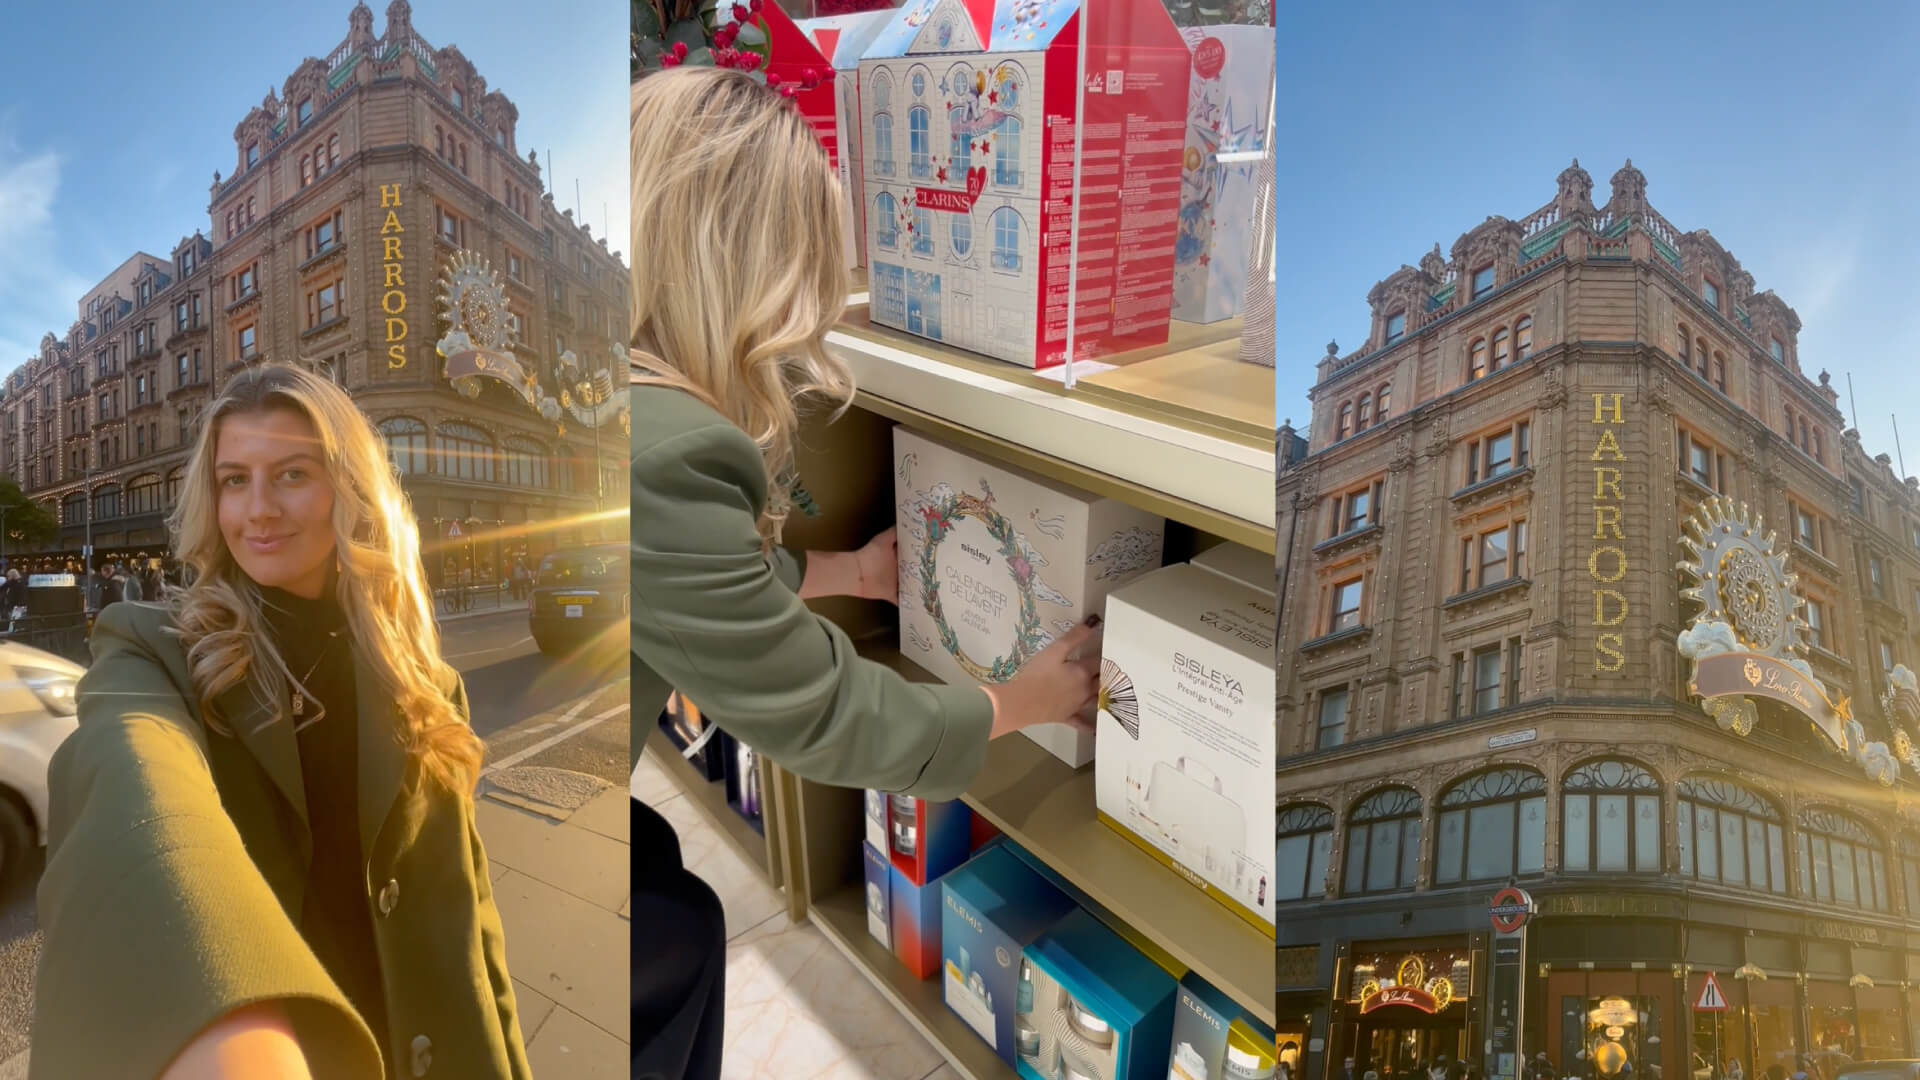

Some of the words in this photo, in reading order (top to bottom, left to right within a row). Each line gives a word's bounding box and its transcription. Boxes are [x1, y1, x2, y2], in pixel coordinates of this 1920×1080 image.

[916, 191, 969, 209] CLARINS
[379, 183, 408, 369] HARRODS
[1588, 393, 1629, 672] HARRODS
[961, 543, 991, 565] sisley
[946, 895, 983, 934] ELEMIS
[1183, 995, 1220, 1031] ELEMIS
